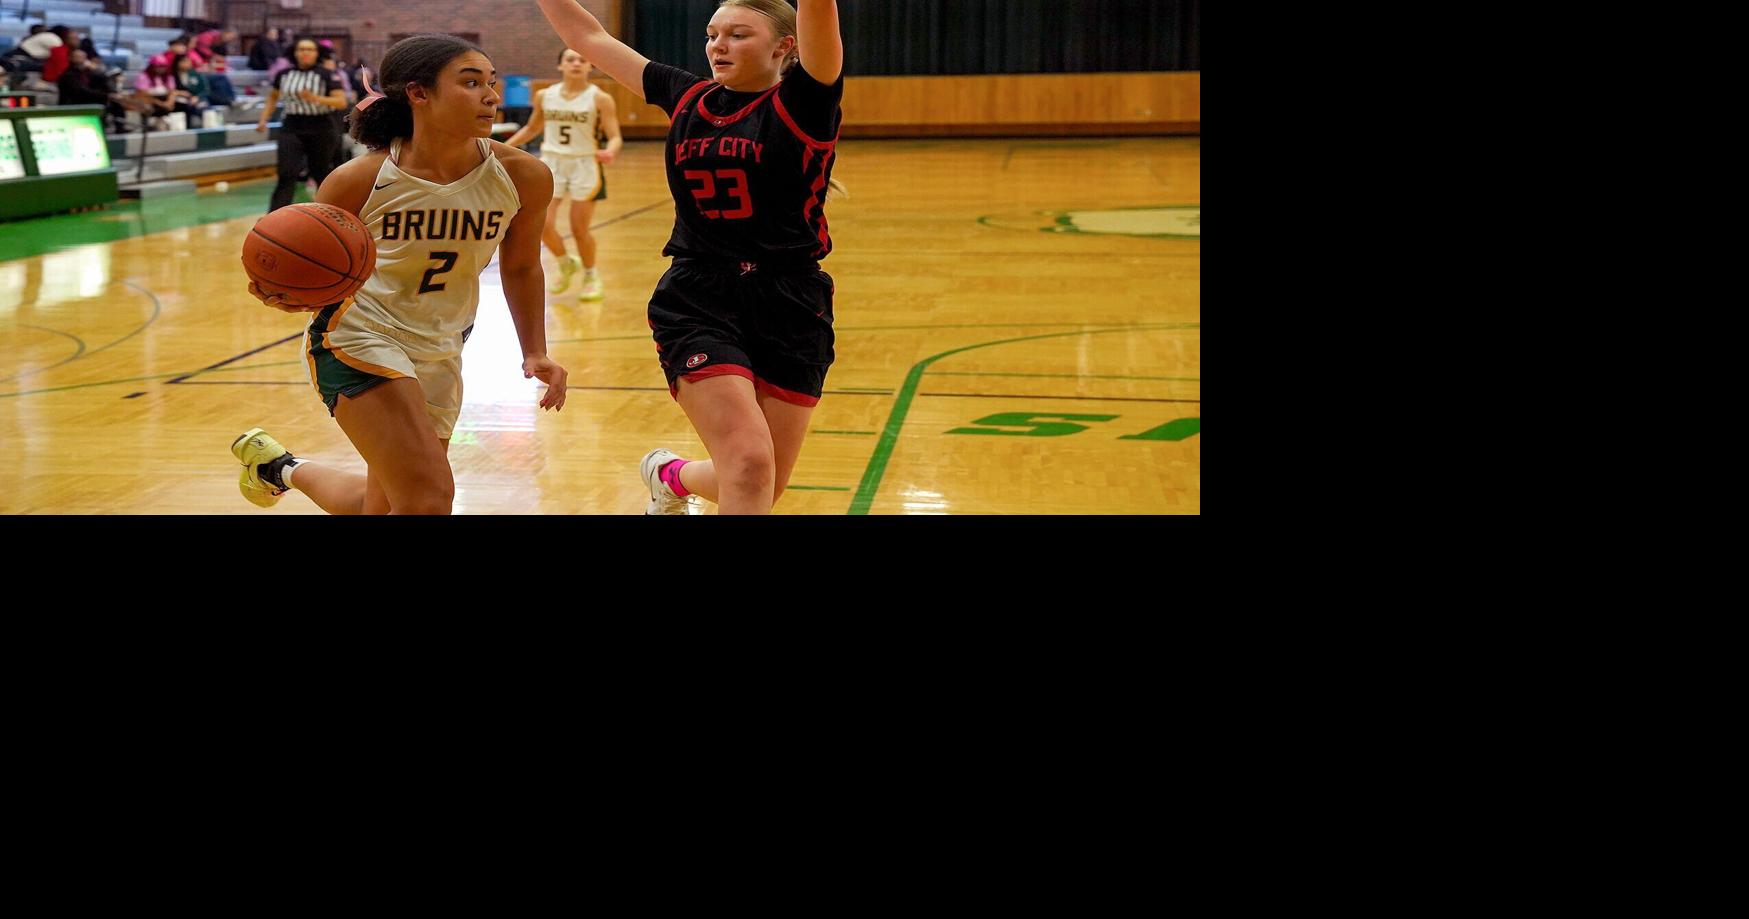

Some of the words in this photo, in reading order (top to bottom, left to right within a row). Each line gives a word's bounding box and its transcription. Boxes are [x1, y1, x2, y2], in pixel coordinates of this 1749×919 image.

[559, 125, 571, 145] 5
[718, 136, 764, 163] CITY
[683, 168, 754, 220] 23
[381, 208, 504, 241] BRUINS
[417, 250, 459, 295] 2
